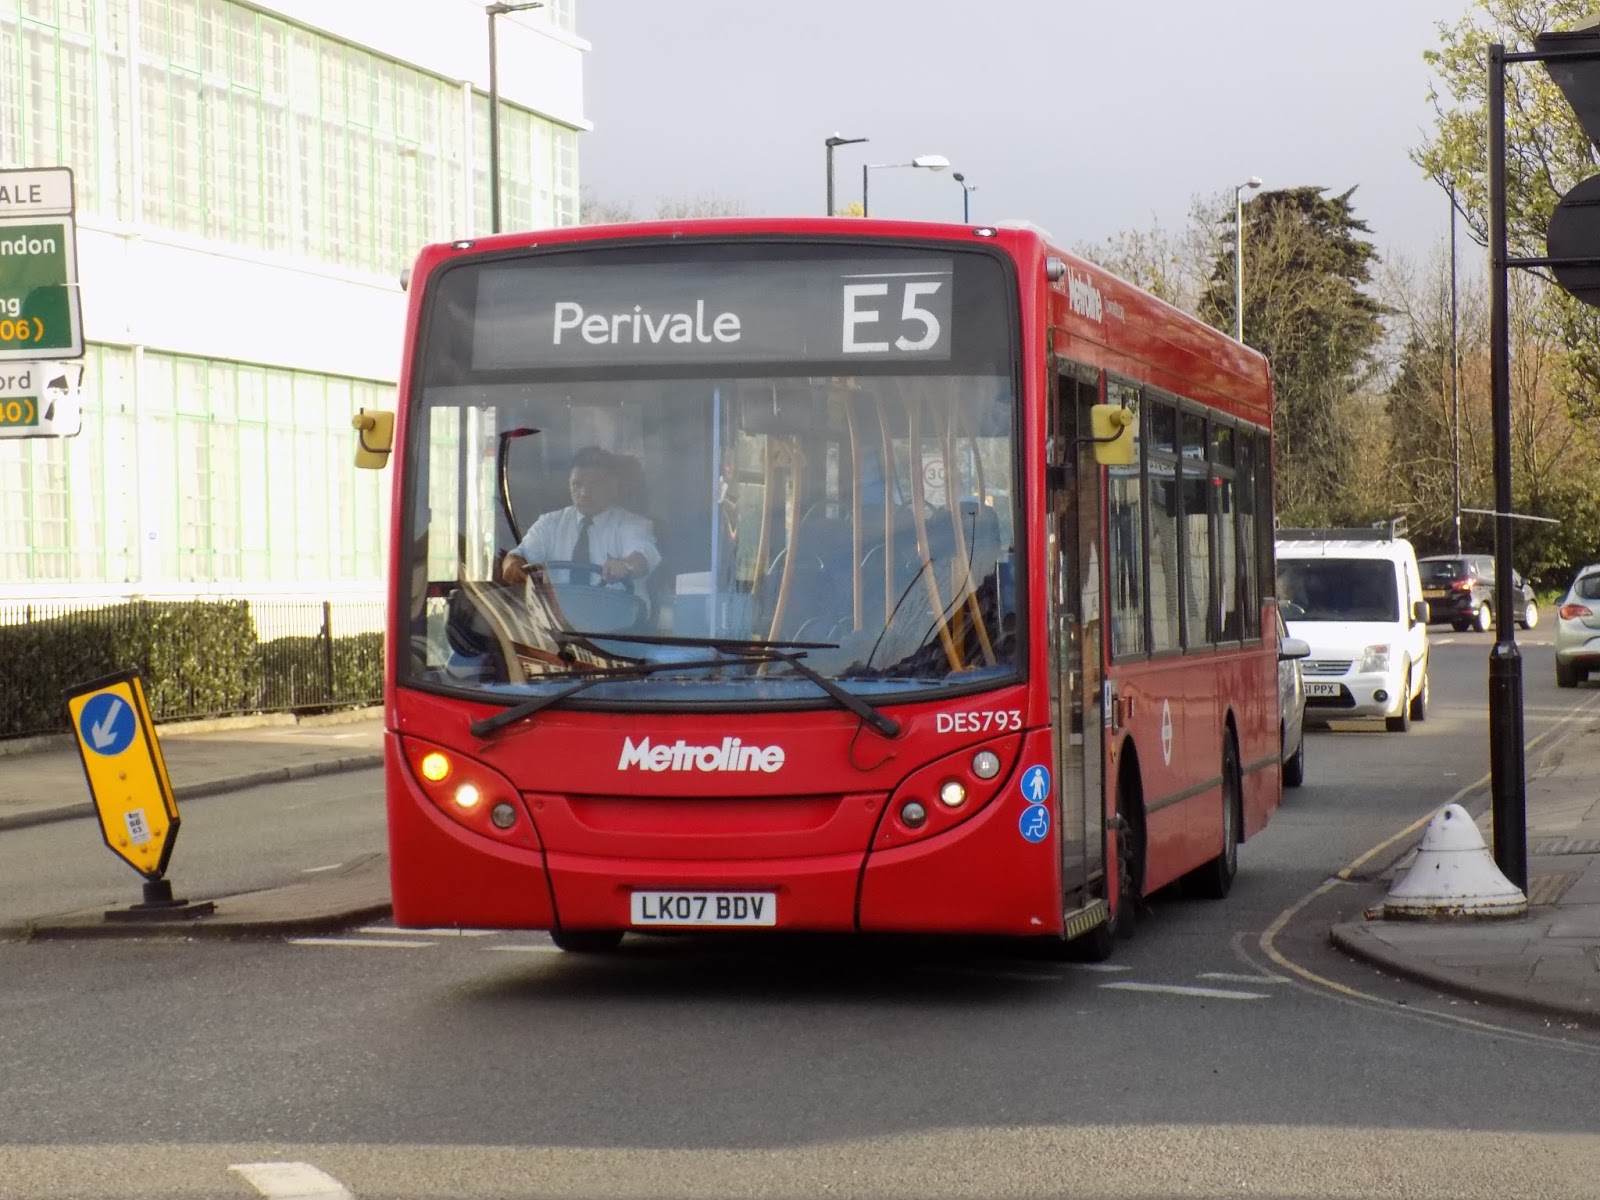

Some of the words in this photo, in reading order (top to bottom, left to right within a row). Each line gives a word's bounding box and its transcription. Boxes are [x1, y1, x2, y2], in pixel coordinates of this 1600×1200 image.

[0, 184, 42, 204] ALE
[1, 235, 56, 256] ndon
[553, 300, 741, 344] Perivale
[842, 282, 943, 353] E5
[0, 399, 34, 424] 0)
[1314, 685, 1334, 695] PPX
[936, 710, 1022, 733] DES793
[617, 736, 785, 773] Metroline
[642, 896, 708, 920] LK07
[715, 896, 764, 920] BDV
